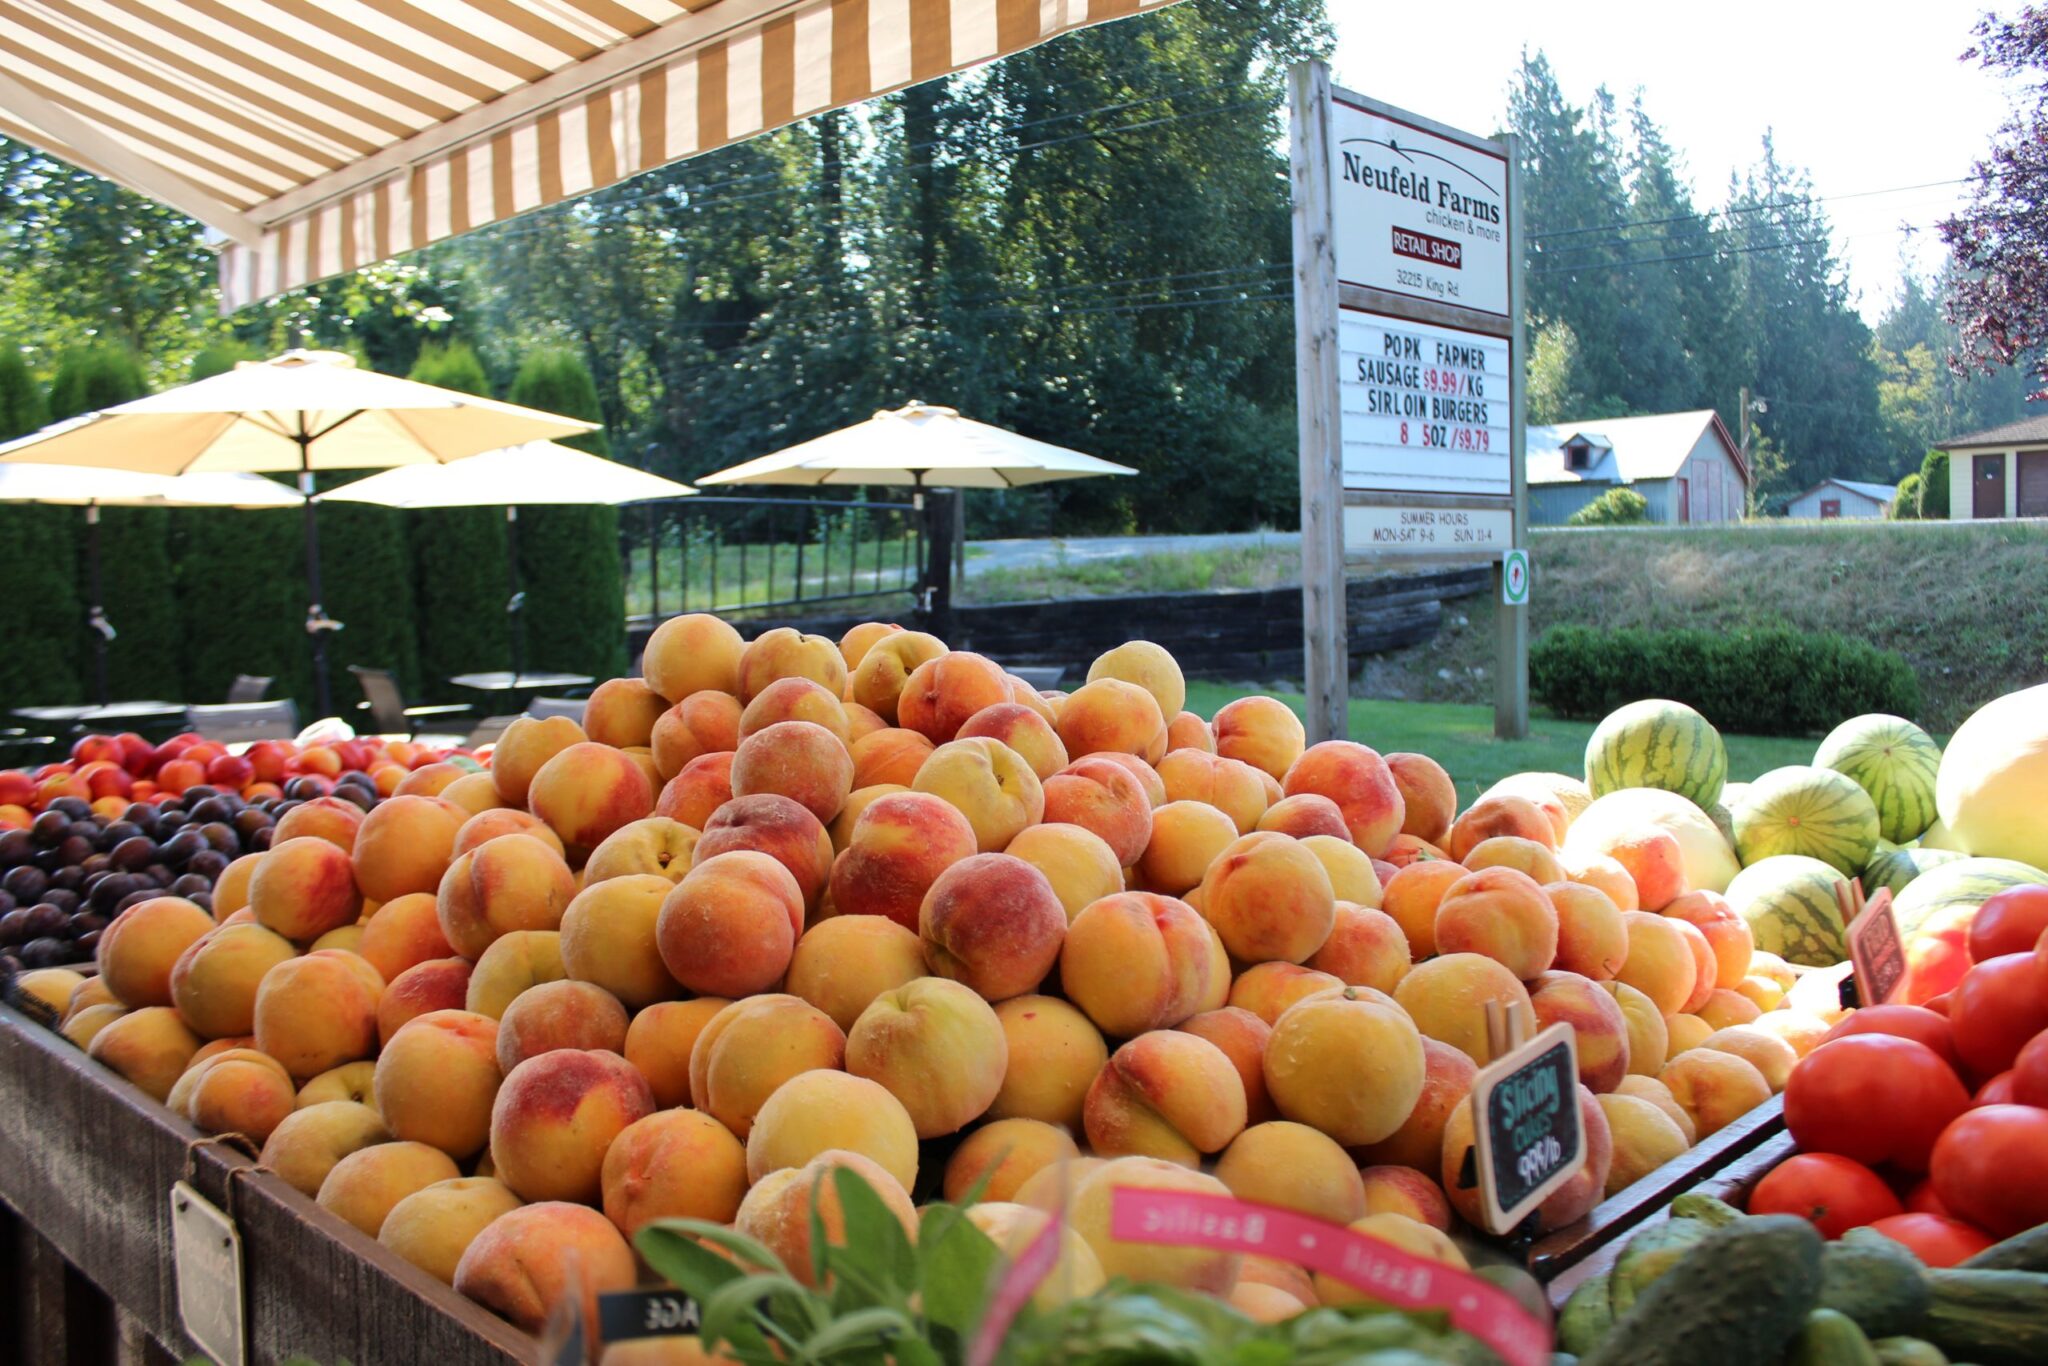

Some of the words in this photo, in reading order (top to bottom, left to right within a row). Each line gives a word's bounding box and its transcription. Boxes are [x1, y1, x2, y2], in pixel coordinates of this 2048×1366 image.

[1343, 151, 1430, 204] Neufeld
[1438, 180, 1500, 225] Farms
[1426, 209, 1466, 234] chicken
[1468, 220, 1474, 236] &
[1477, 224, 1500, 243] more
[1394, 232, 1430, 254] RETAIL
[1432, 244, 1461, 265] SHOP
[1396, 268, 1423, 288] 32215
[1426, 278, 1444, 298] King
[1384, 334, 1421, 361] PORK
[1437, 343, 1485, 371] FARMER
[1358, 358, 1420, 389] SAUSAGE
[1368, 390, 1427, 418] SIRLOIN
[1433, 399, 1488, 425] BURGERS
[1400, 422, 1408, 445] 8
[1373, 528, 1416, 542] MON-SAT
[1420, 529, 1435, 542] 9-6
[1454, 530, 1473, 542] SUN
[1401, 512, 1435, 525] SUMMER
[1439, 513, 1469, 526] HOURS
